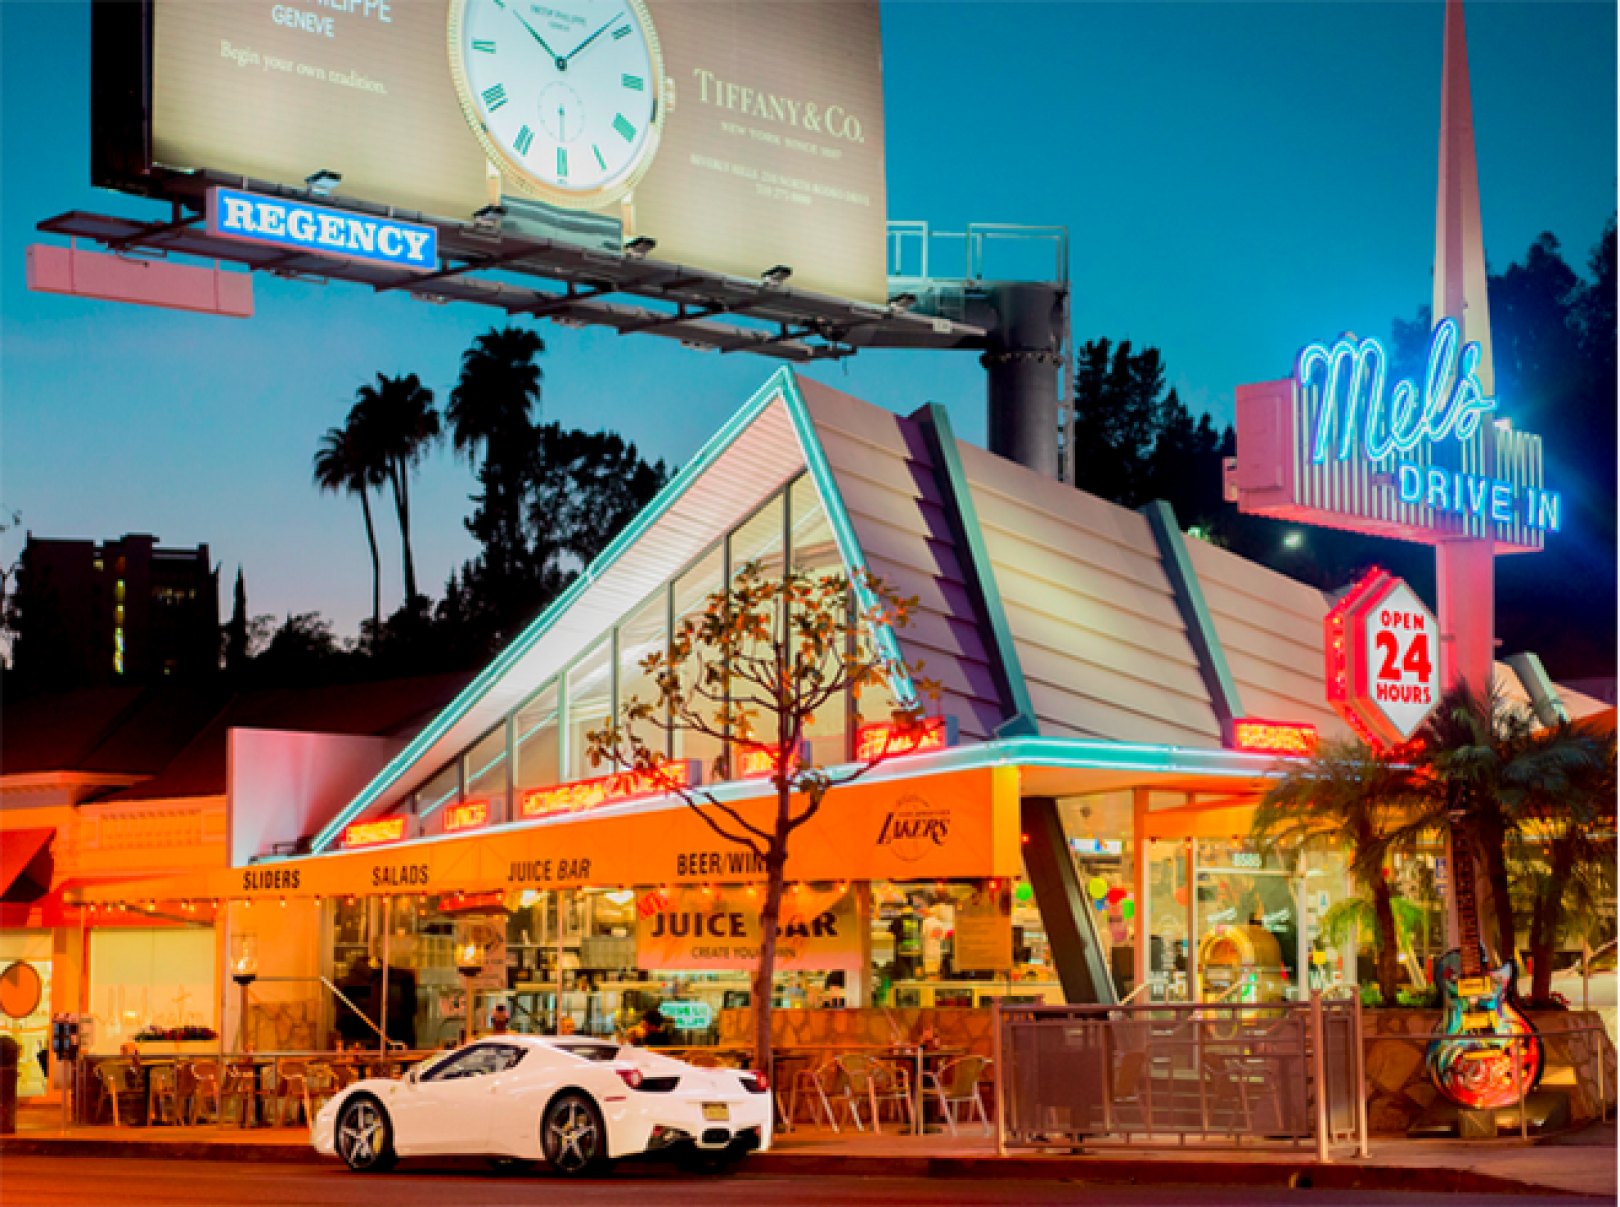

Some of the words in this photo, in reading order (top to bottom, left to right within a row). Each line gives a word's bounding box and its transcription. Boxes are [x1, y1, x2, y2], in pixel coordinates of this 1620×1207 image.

[271, 4, 335, 38] GENEVE
[308, 0, 393, 23] IPPE
[220, 39, 261, 67] Begin
[262, 55, 294, 72] your
[296, 63, 326, 80] own
[222, 197, 430, 260] REGENCY
[1299, 317, 1498, 464] Mels
[1400, 461, 1513, 522] DRIVE
[1526, 488, 1562, 532] IN
[1380, 610, 1424, 631] OPEN
[1375, 631, 1432, 682] 24
[1376, 683, 1432, 704] HOURS
[372, 865, 428, 886] SALADS
[507, 860, 552, 882] JUICE
[557, 858, 592, 879] BAR
[677, 852, 768, 876] BEER/WIN
[243, 870, 300, 890] SLIDERS
[652, 912, 747, 937] JUICE
[760, 911, 838, 937] AR
[733, 946, 758, 960] YOU
